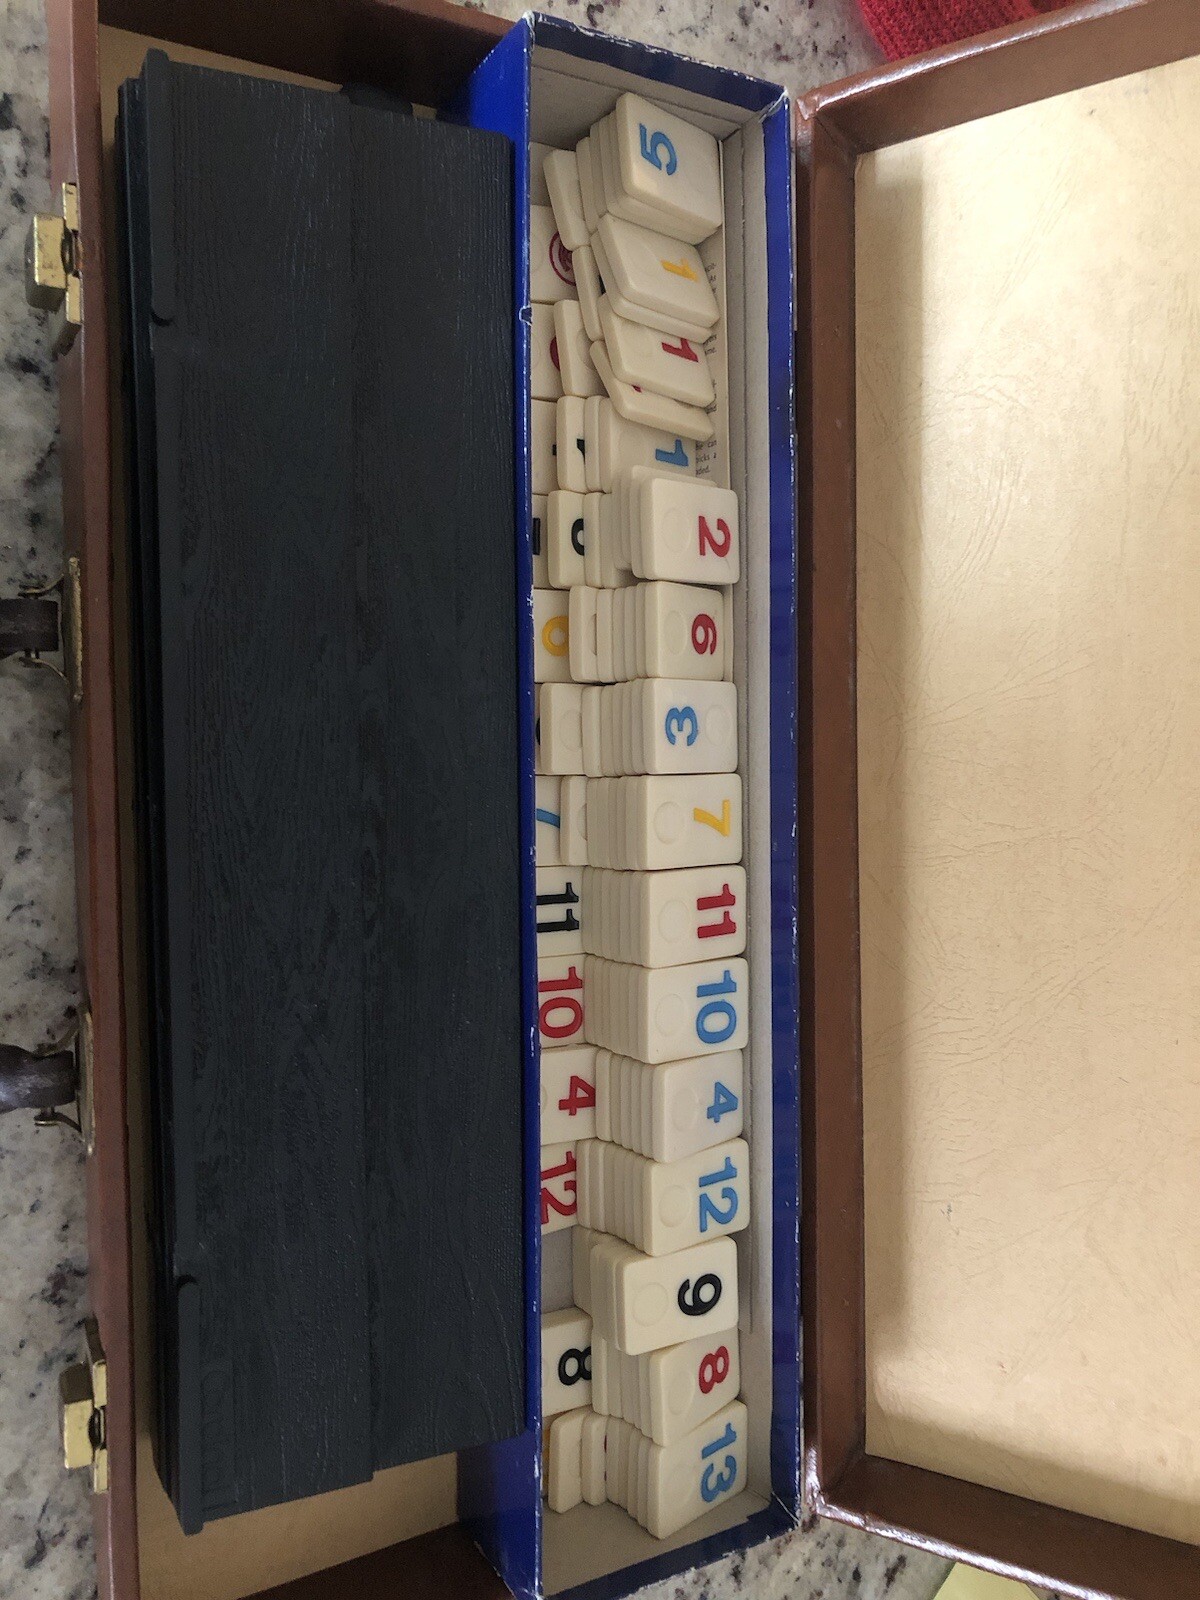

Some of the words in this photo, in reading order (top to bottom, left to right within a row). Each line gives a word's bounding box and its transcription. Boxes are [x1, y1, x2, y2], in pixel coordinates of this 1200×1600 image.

[639, 123, 677, 176] 5
[661, 258, 698, 283] 1
[661, 337, 699, 362] 1
[655, 438, 689, 467] 1
[698, 515, 731, 557] 2
[691, 613, 717, 655] 6
[665, 706, 699, 746] 3
[693, 799, 731, 837] 7
[536, 882, 580, 933] 11
[697, 883, 736, 939] 11
[538, 966, 583, 1038] 10
[695, 970, 737, 1044] 10
[558, 1075, 596, 1116] 4
[707, 1081, 739, 1123] 4
[540, 1151, 577, 1225] 12
[698, 1157, 739, 1232] 12
[677, 1273, 722, 1317] 9
[558, 1346, 592, 1386] 8
[699, 1346, 730, 1394] 8
[701, 1423, 737, 1503] 13
